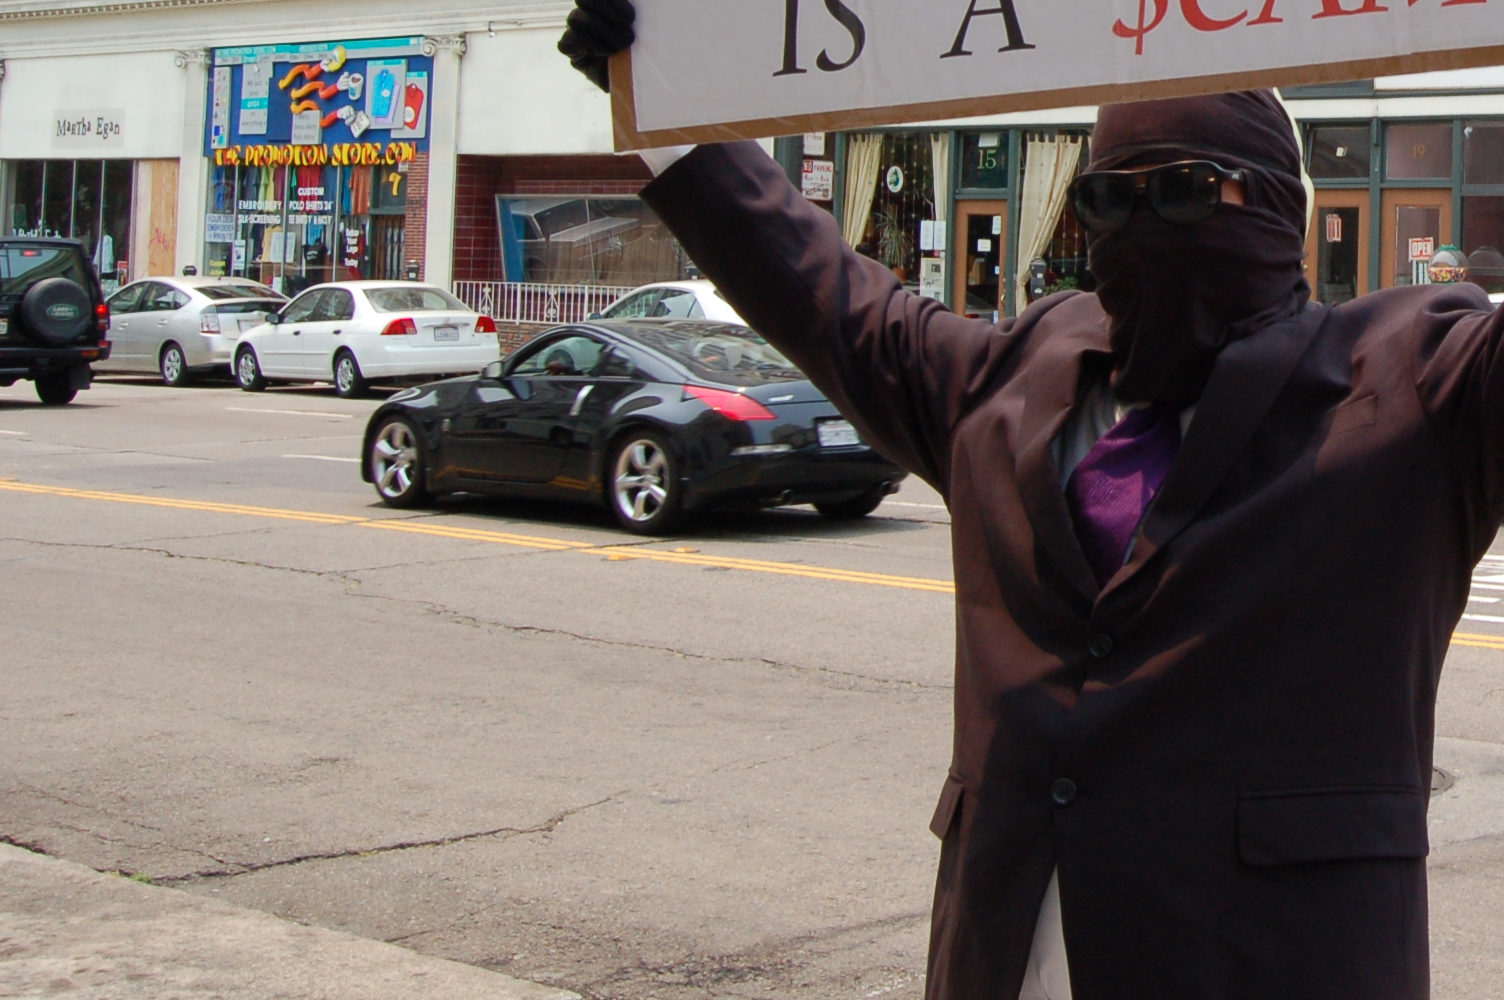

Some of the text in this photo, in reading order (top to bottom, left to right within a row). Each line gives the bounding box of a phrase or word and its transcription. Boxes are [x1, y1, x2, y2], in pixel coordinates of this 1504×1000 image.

[96, 117, 120, 140] Egan
[215, 145, 241, 167] THE
[245, 143, 328, 167] PROMOTION
[977, 149, 997, 170] 15
[1413, 144, 1426, 160] 19
[1412, 241, 1432, 258] OPEN
